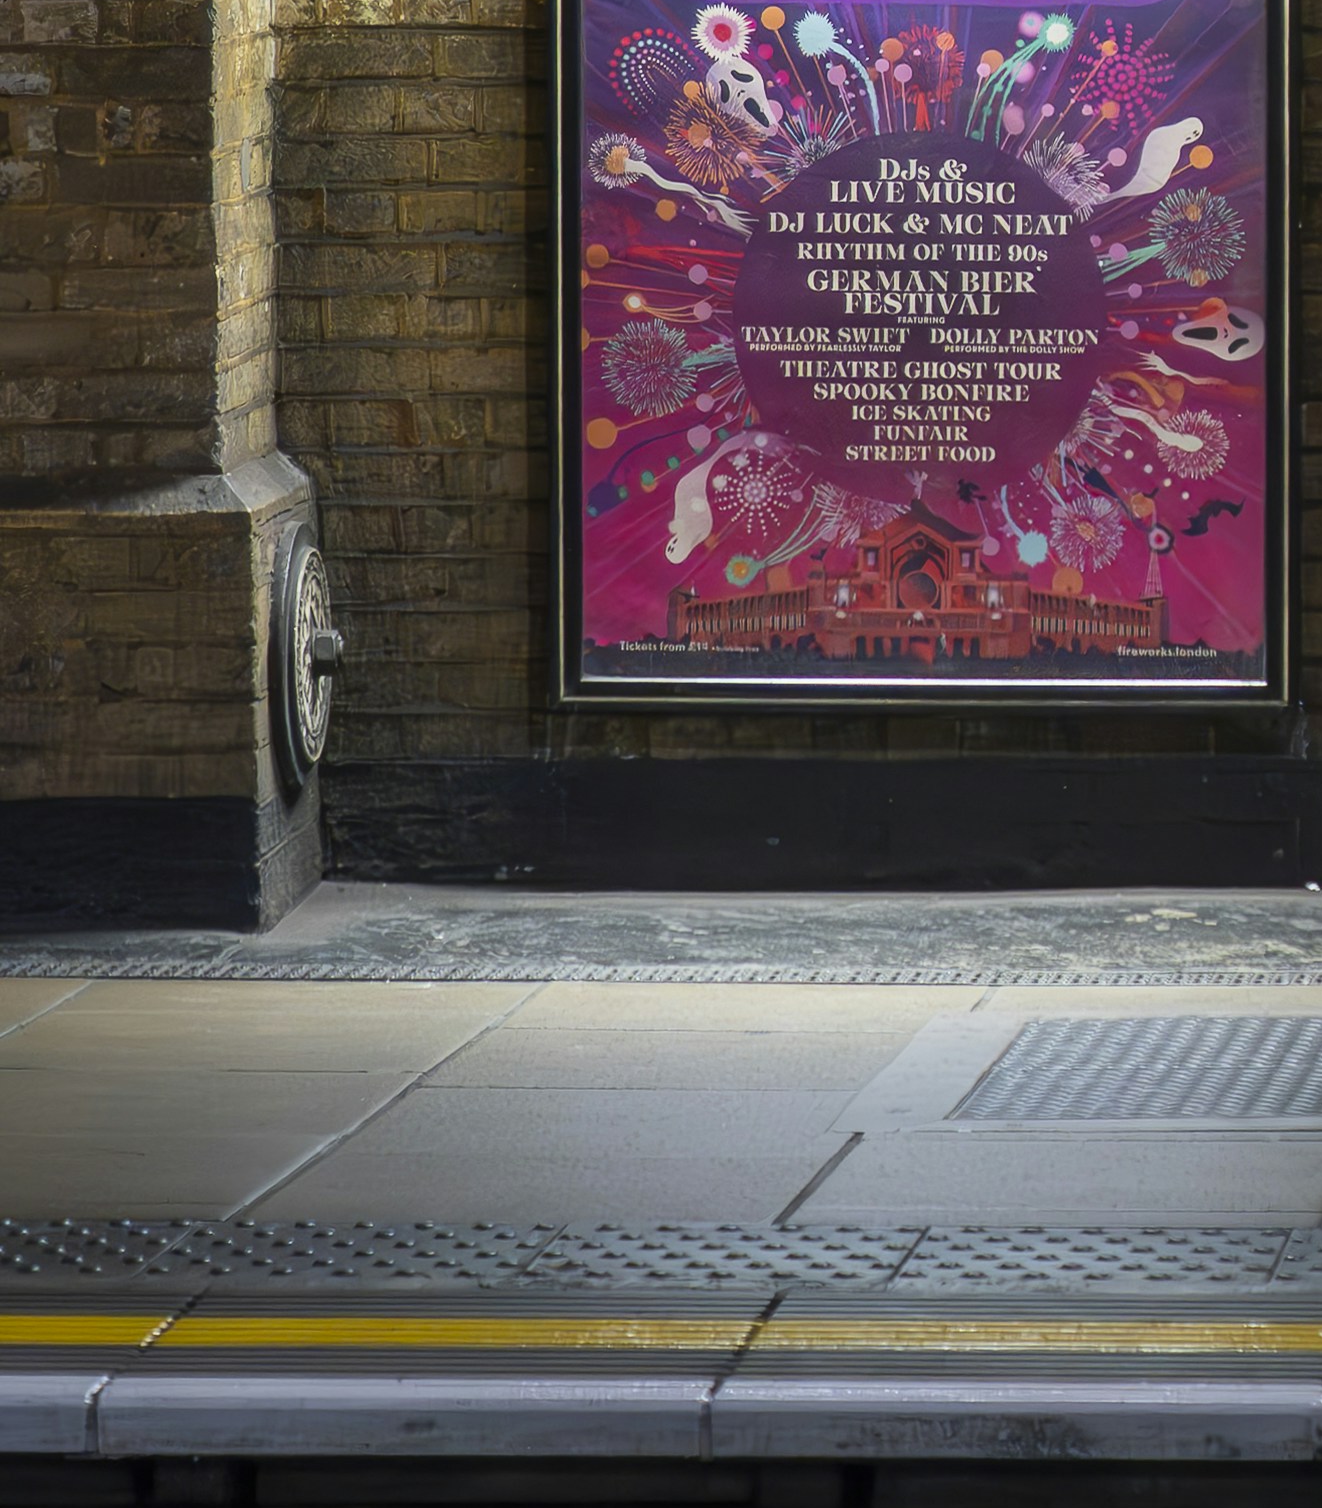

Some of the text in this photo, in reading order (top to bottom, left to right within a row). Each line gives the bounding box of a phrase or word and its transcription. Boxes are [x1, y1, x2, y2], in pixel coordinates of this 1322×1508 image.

[879, 158, 968, 181] DJs &
[830, 180, 1016, 204] LIVE MUSIC
[769, 211, 1073, 236] DJ LUCK & MC NEAT
[797, 242, 1048, 262] RHYTHM OF THE 90s
[807, 269, 1037, 294] GERMAN BIER
[844, 292, 1000, 316] FESTIVAL
[897, 316, 946, 325] FEATURING
[741, 326, 910, 344] TAYLOR SWIFT
[930, 328, 1099, 346] DOLLY PARTON
[749, 343, 902, 353] PERFORMED BY FEARLESSLY TAYLOR
[944, 344, 1085, 354] PERFORMED BY THE DOLLY SHOW
[779, 360, 1062, 380] THEATRE GHOST TOUR
[813, 382, 1030, 402] SPOOKY BONFIRE
[852, 405, 991, 422] ICE SKATING
[874, 425, 969, 441] FUNFAIR
[846, 445, 996, 462] STREET FOOD
[619, 640, 657, 651] Tickets
[659, 640, 686, 652] from
